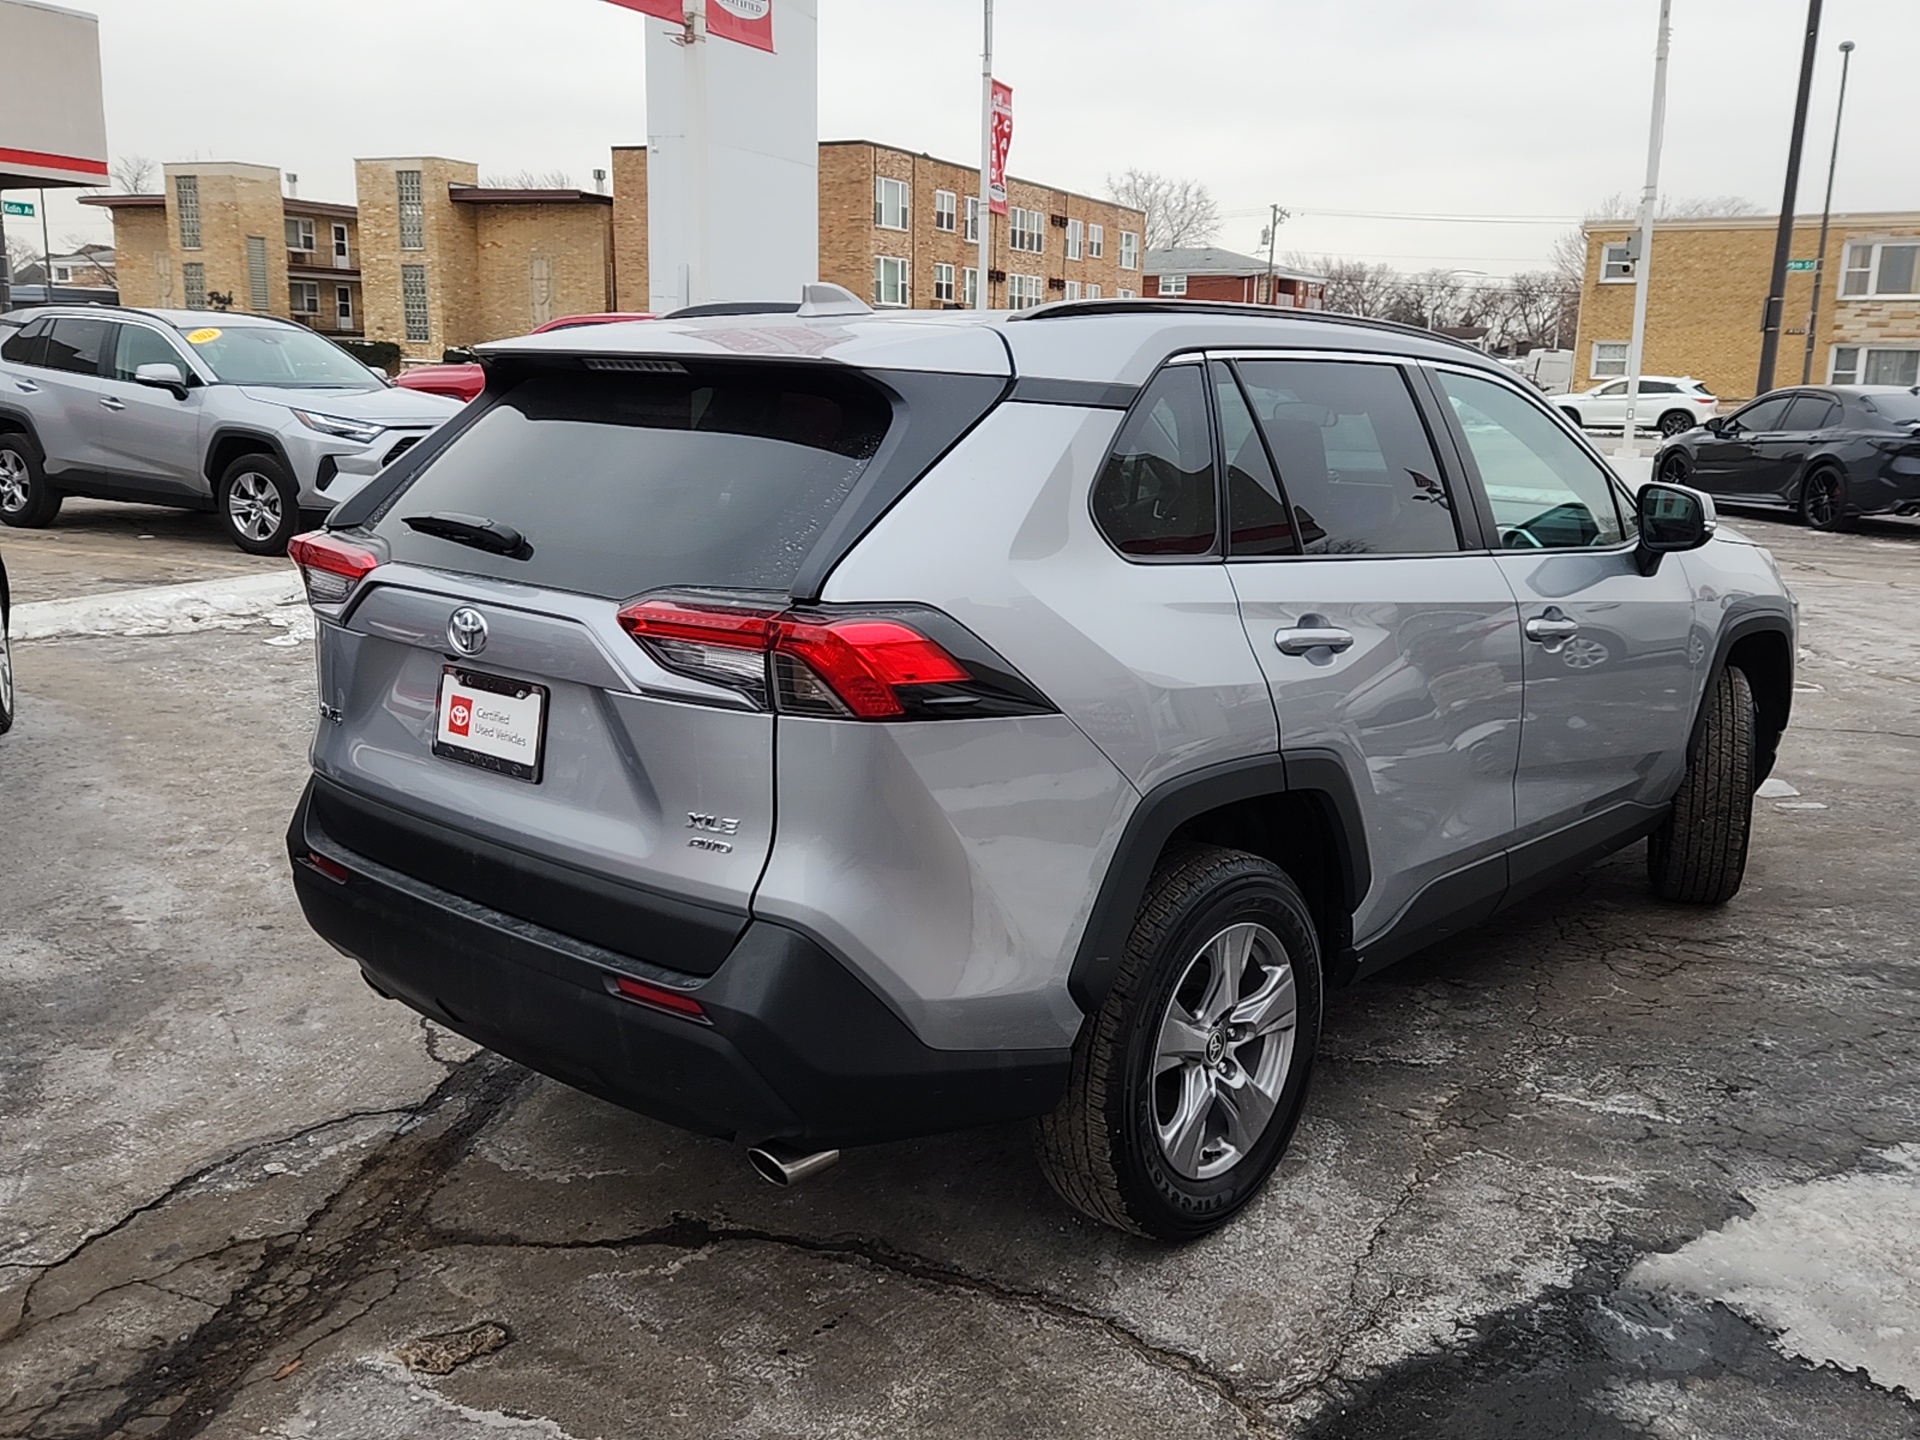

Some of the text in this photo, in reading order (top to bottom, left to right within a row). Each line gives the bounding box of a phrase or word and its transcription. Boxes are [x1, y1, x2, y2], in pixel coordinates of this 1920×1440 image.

[476, 707, 510, 726] Certified
[474, 723, 494, 738] Used
[496, 729, 527, 747] Vehicles
[686, 811, 741, 835] XLE
